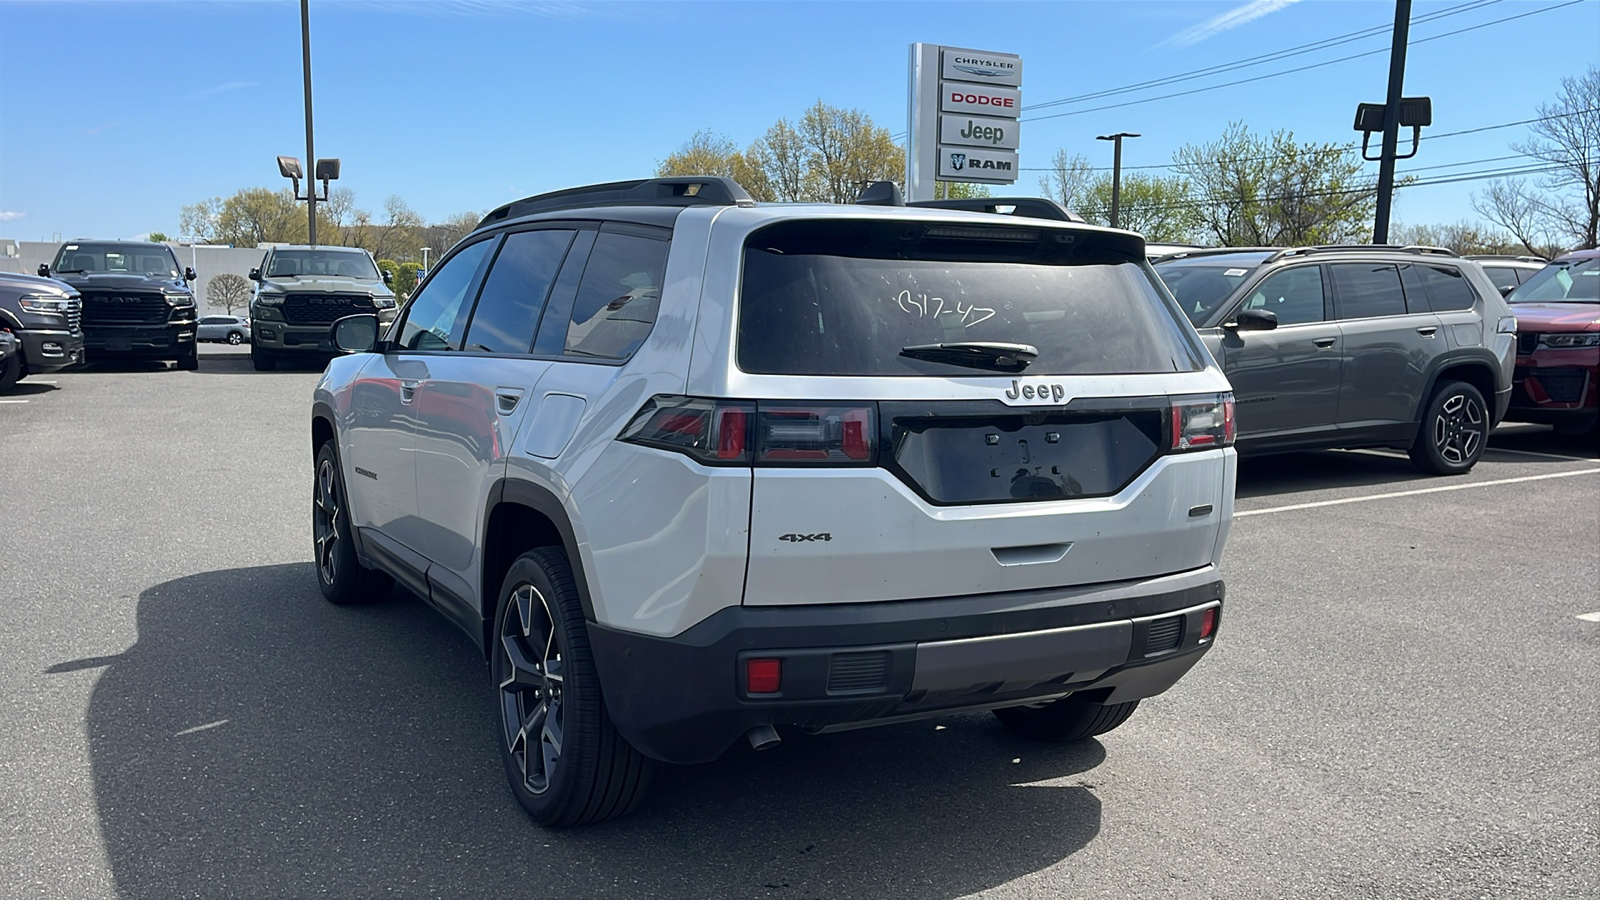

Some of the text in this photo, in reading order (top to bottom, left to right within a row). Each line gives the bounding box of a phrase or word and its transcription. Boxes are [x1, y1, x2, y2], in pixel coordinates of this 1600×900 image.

[954, 57, 1014, 69] CHRYSLER
[951, 92, 1014, 108] DODGE
[960, 120, 1004, 145] Jeep
[968, 158, 1012, 171] RAM
[1005, 380, 1065, 402] Jeep
[778, 532, 833, 543] 4x4
